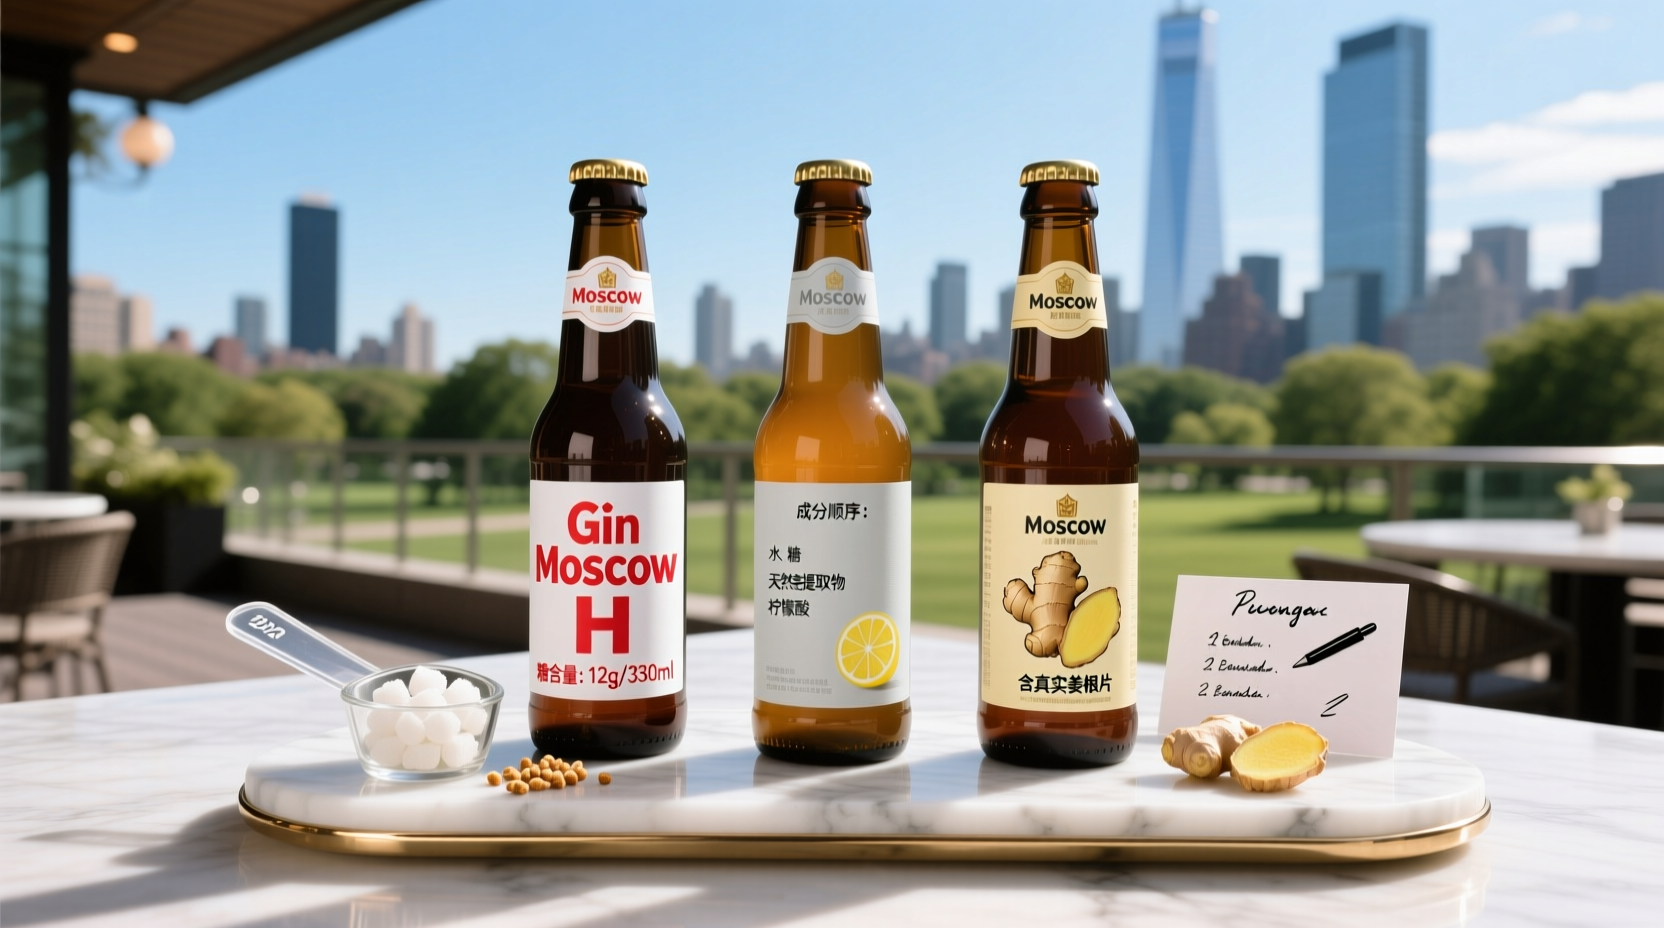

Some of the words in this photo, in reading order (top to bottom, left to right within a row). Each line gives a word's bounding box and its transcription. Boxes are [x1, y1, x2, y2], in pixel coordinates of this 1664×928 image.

[572, 287, 642, 304] Moscow
[800, 289, 866, 305] Moscow
[1029, 293, 1097, 309] Moscow
[567, 501, 640, 545] Gin
[1025, 515, 1106, 535] Moscow
[768, 545, 783, 562] 水
[536, 544, 678, 586] Moscow
[575, 596, 630, 655] H
[588, 659, 674, 690] 12g/330ml
